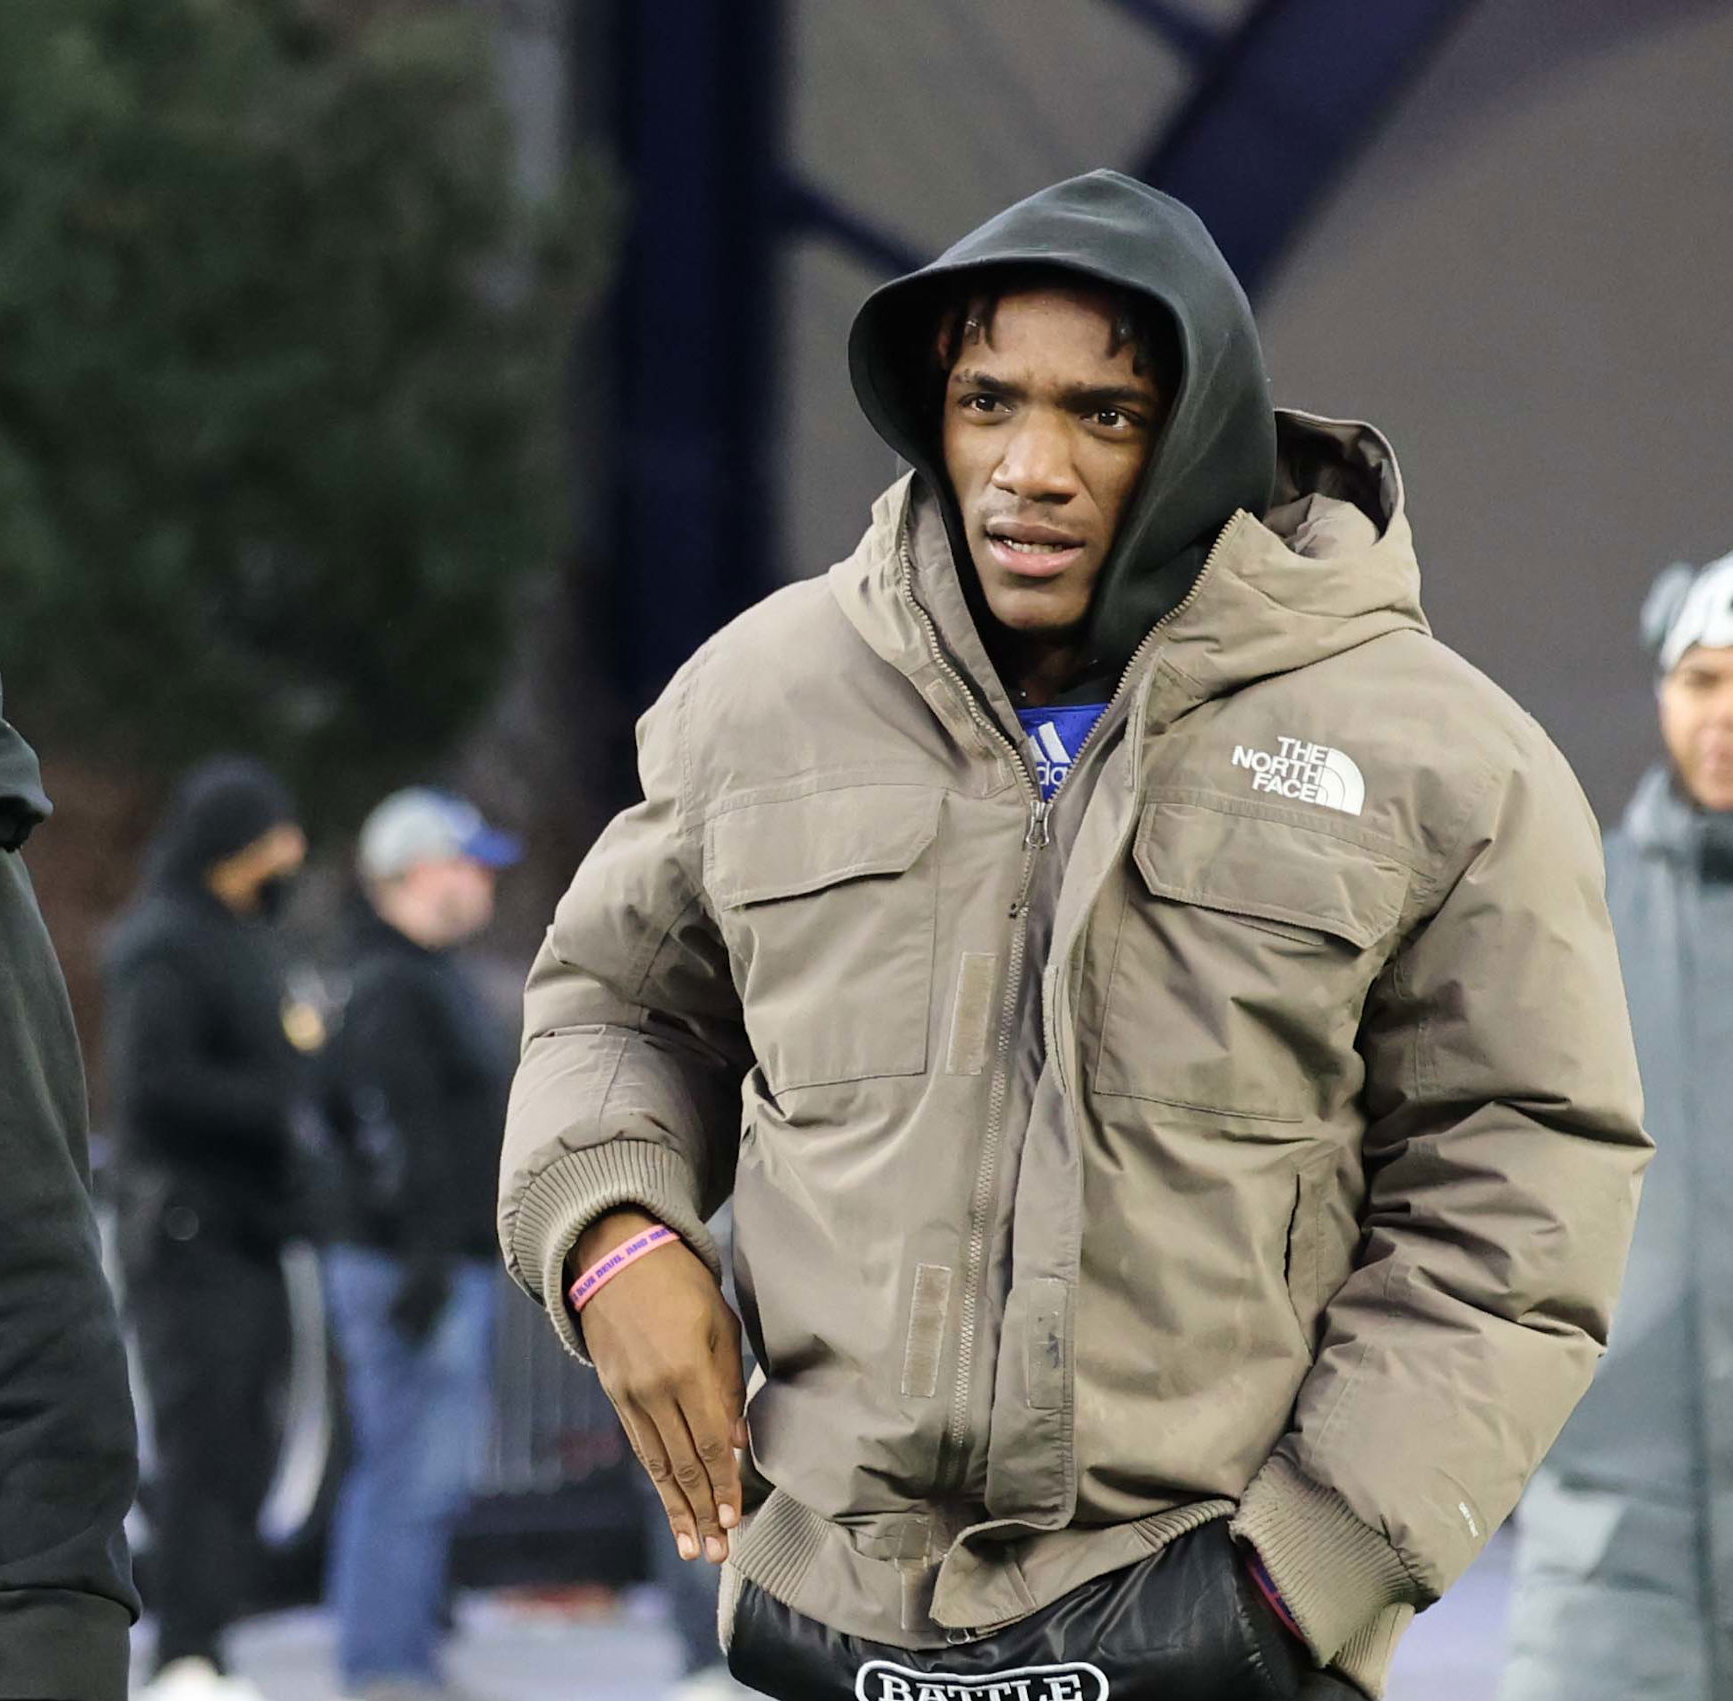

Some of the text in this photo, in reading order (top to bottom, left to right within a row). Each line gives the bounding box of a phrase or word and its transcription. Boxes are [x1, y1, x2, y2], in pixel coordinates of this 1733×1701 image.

[1231, 745, 1323, 785] NORTH
[1277, 736, 1330, 766] THE
[1252, 771, 1319, 803] FACE
